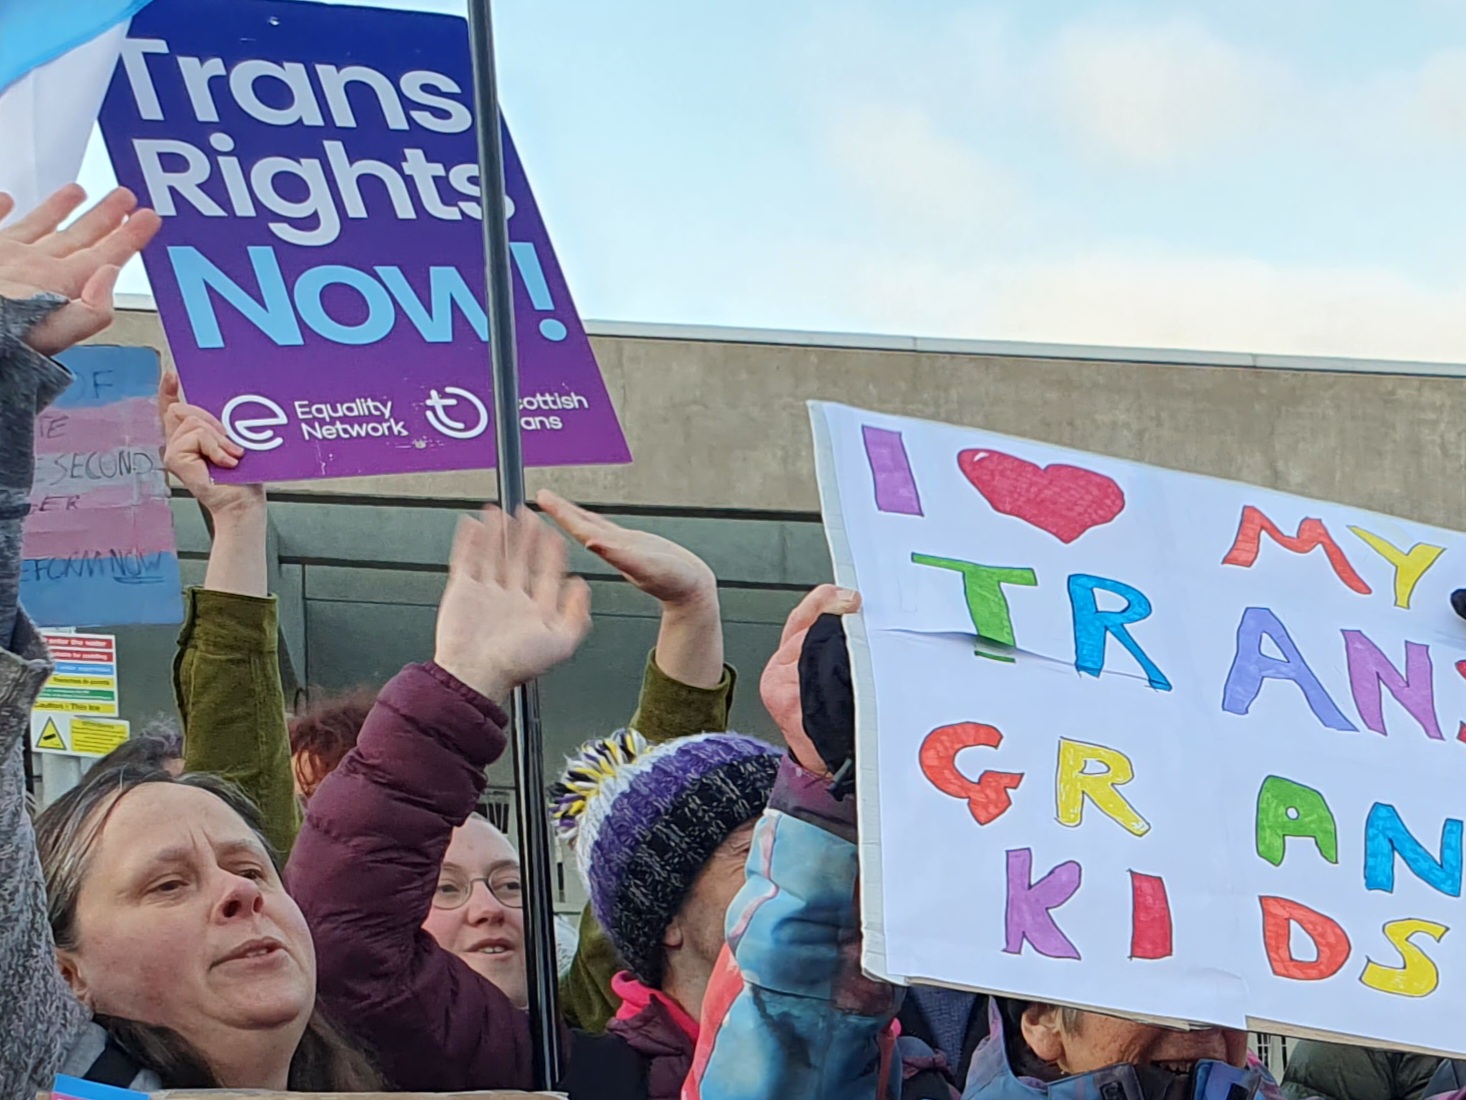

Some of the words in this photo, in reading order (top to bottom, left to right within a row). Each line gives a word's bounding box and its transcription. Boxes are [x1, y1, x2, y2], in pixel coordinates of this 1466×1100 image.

[117, 37, 472, 134] Trans
[131, 133, 516, 247] Rights
[167, 241, 568, 349] Now!
[294, 397, 392, 421] Equality
[301, 418, 409, 441] Network
[519, 391, 589, 410] ottish
[520, 415, 564, 431] ans
[862, 424, 925, 517] I
[1221, 505, 1446, 609] MY
